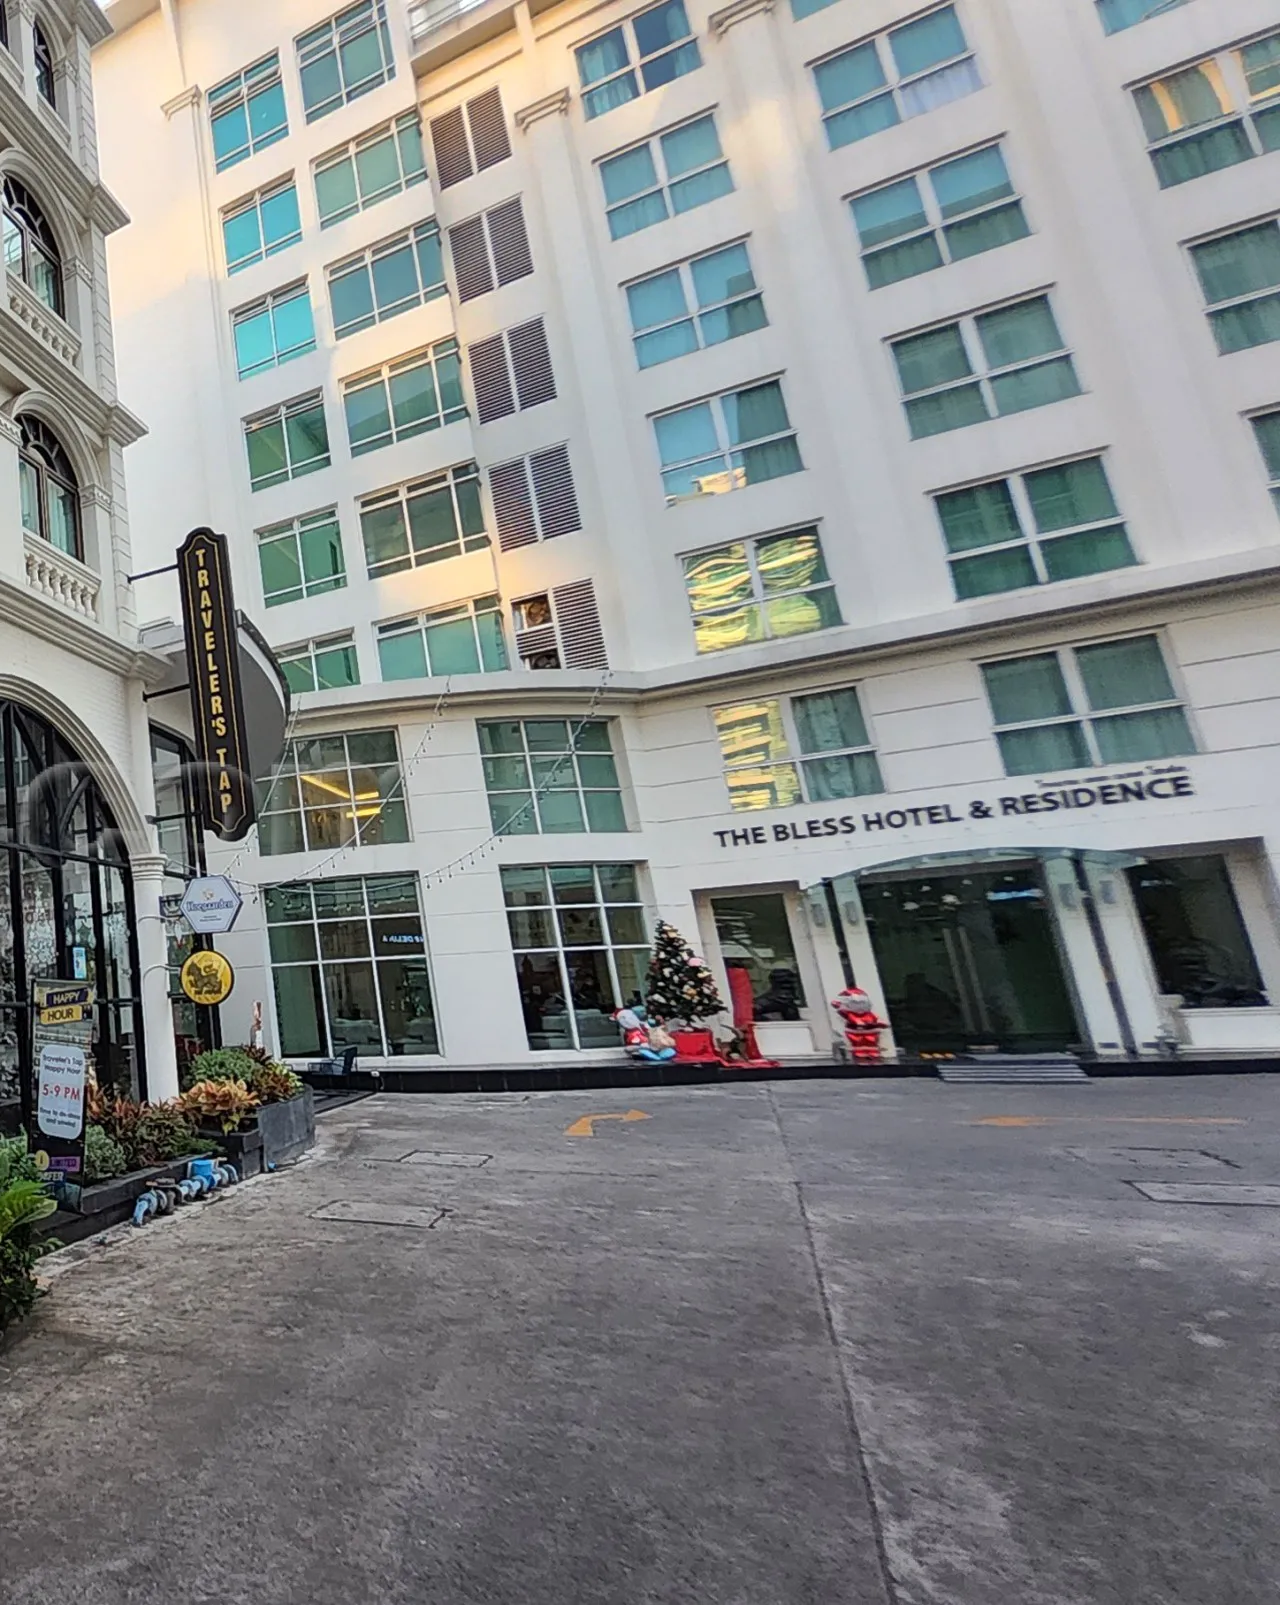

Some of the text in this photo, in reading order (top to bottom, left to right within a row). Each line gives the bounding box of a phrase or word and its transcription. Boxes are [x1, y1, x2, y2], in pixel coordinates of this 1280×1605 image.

[195, 549, 234, 813] TRAVELER'S TAP
[714, 826, 767, 848] THE
[772, 815, 856, 842] BLESS
[862, 804, 964, 831] HOTEL
[967, 799, 994, 819] &
[999, 775, 1196, 815] RESIDENCE
[53, 991, 80, 1004] HAPPY
[47, 1007, 74, 1021] HOUR
[64, 1087, 80, 1101] PM
